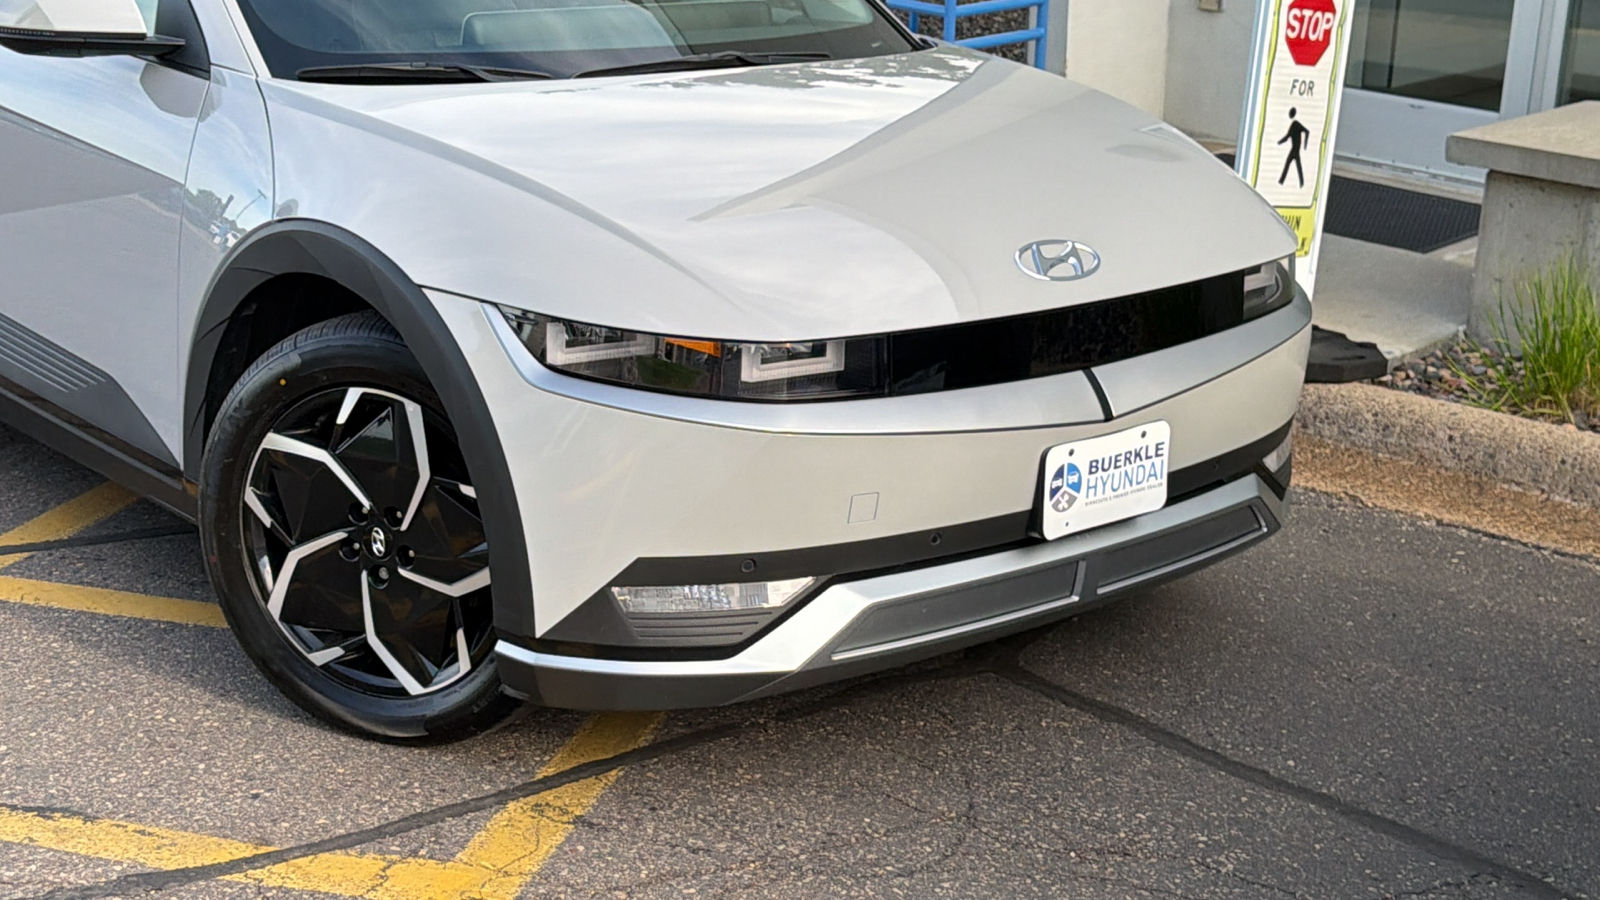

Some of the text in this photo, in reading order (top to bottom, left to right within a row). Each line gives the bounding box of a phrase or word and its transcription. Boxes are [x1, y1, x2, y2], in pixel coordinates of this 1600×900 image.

[1286, 7, 1334, 42] STOP
[1290, 79, 1315, 97] FOR
[1088, 441, 1165, 475] BUERKLE
[1086, 459, 1164, 499] HYUNDAI
